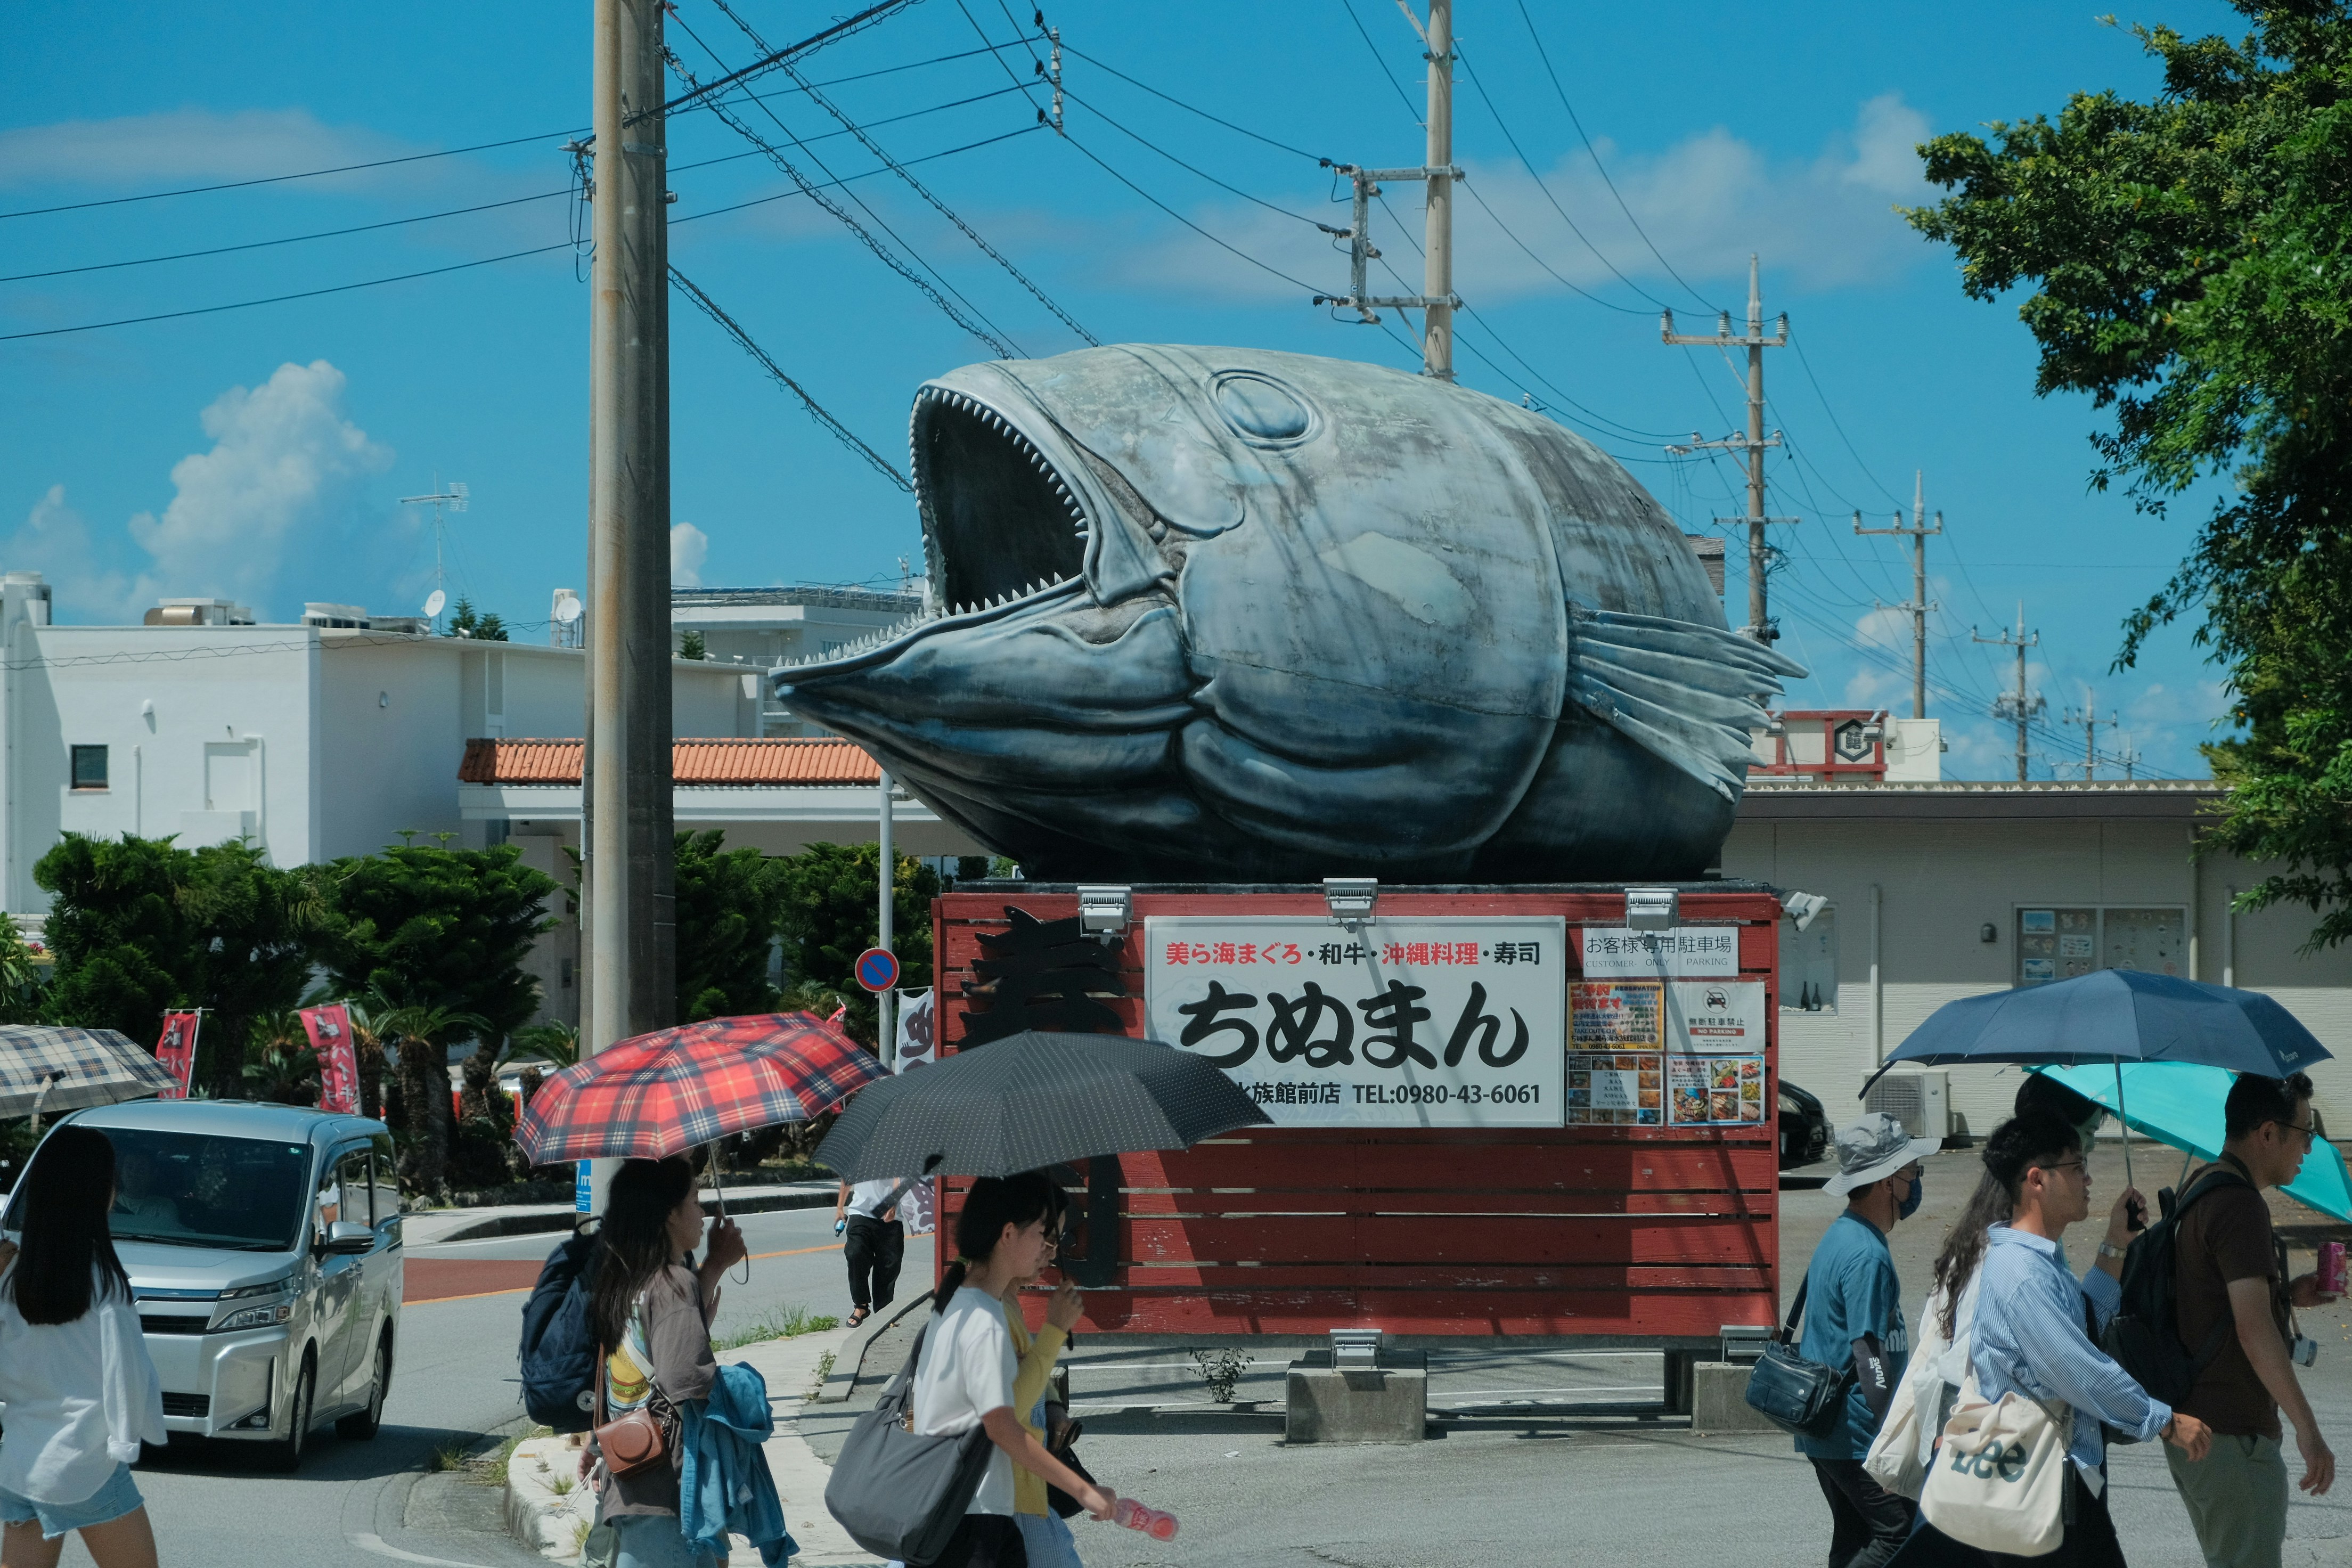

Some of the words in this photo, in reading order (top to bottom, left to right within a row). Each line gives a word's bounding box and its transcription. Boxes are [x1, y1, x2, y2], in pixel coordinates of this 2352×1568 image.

[1178, 979, 1529, 1069] ちぬまん
[1352, 1084, 1540, 1104] TEL:0980-43-6061
[1951, 1440, 2027, 1483] Lee
